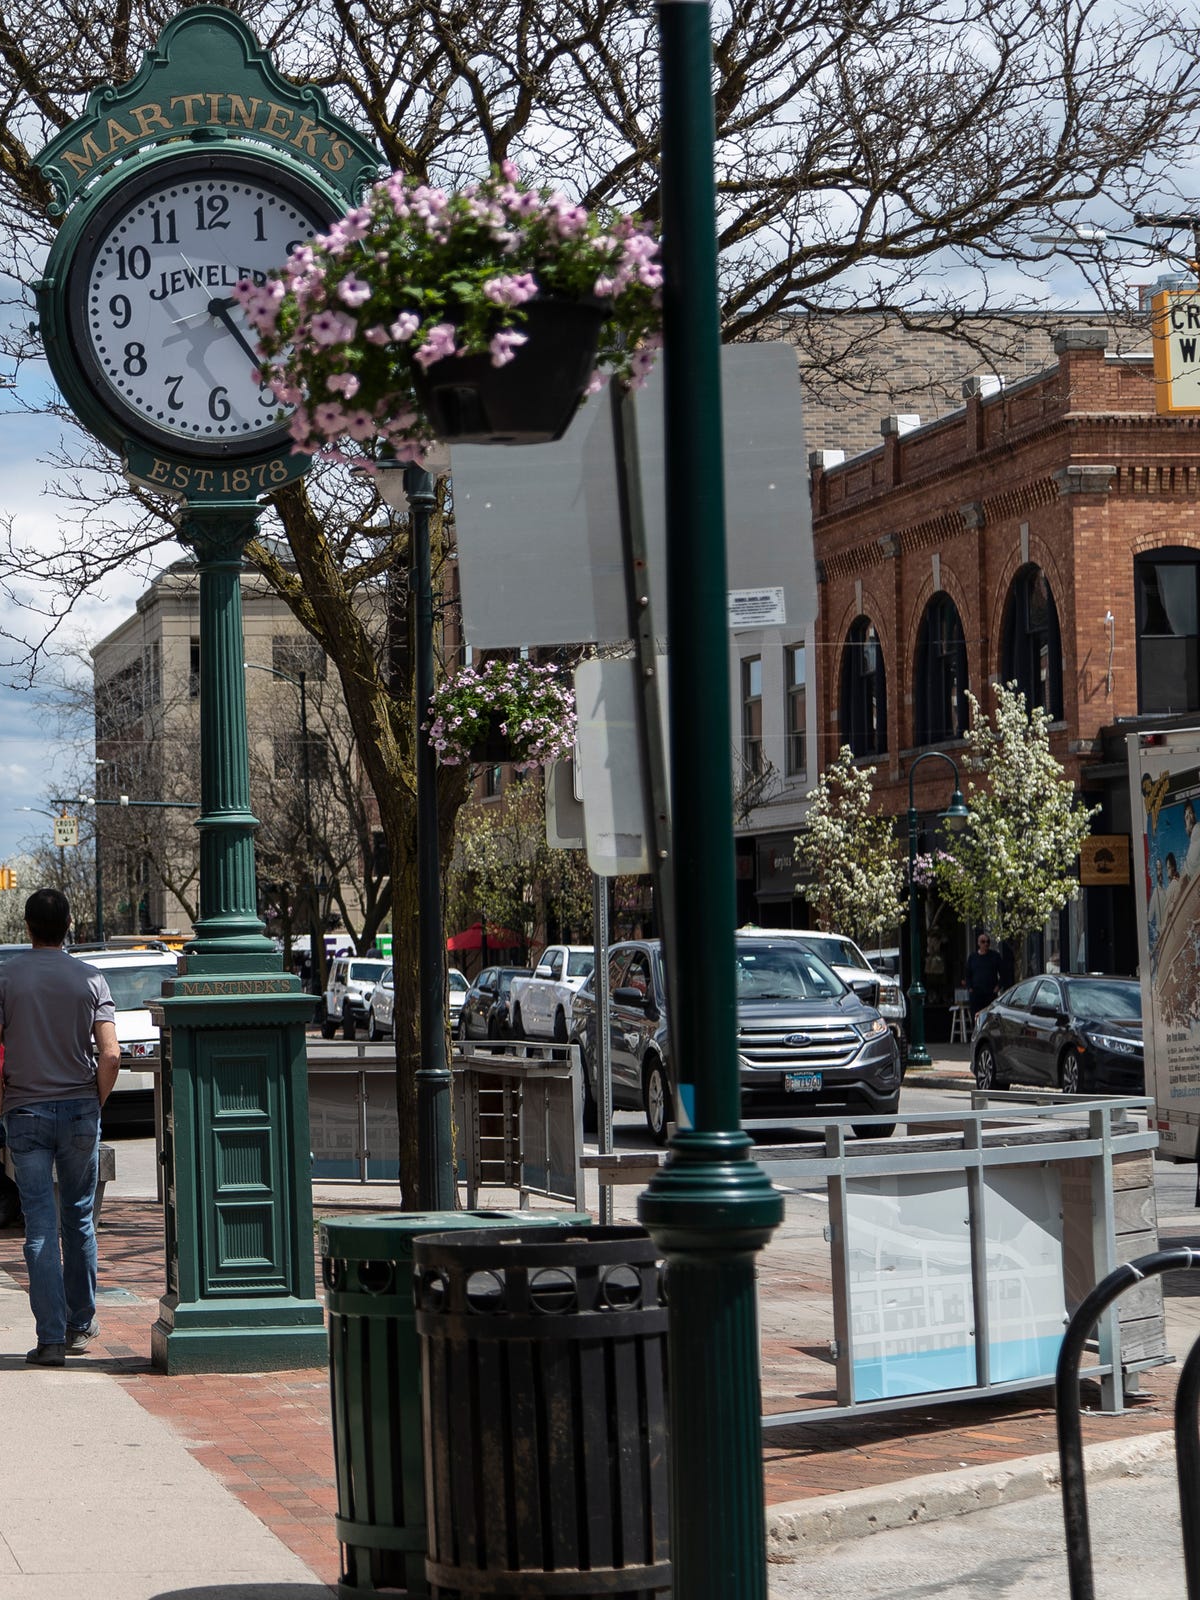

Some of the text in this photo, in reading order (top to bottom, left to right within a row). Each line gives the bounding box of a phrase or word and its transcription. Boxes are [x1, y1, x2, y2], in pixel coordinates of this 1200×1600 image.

[59, 93, 355, 180] MARTINEK'S
[151, 208, 180, 244] 11
[194, 194, 231, 231] 12
[253, 206, 268, 242] 1
[115, 244, 152, 281] 10
[109, 294, 132, 329] 9
[123, 341, 148, 377] 8
[164, 375, 184, 411] 7
[208, 386, 231, 422] 6
[183, 979, 291, 995] MARTINEK'S
